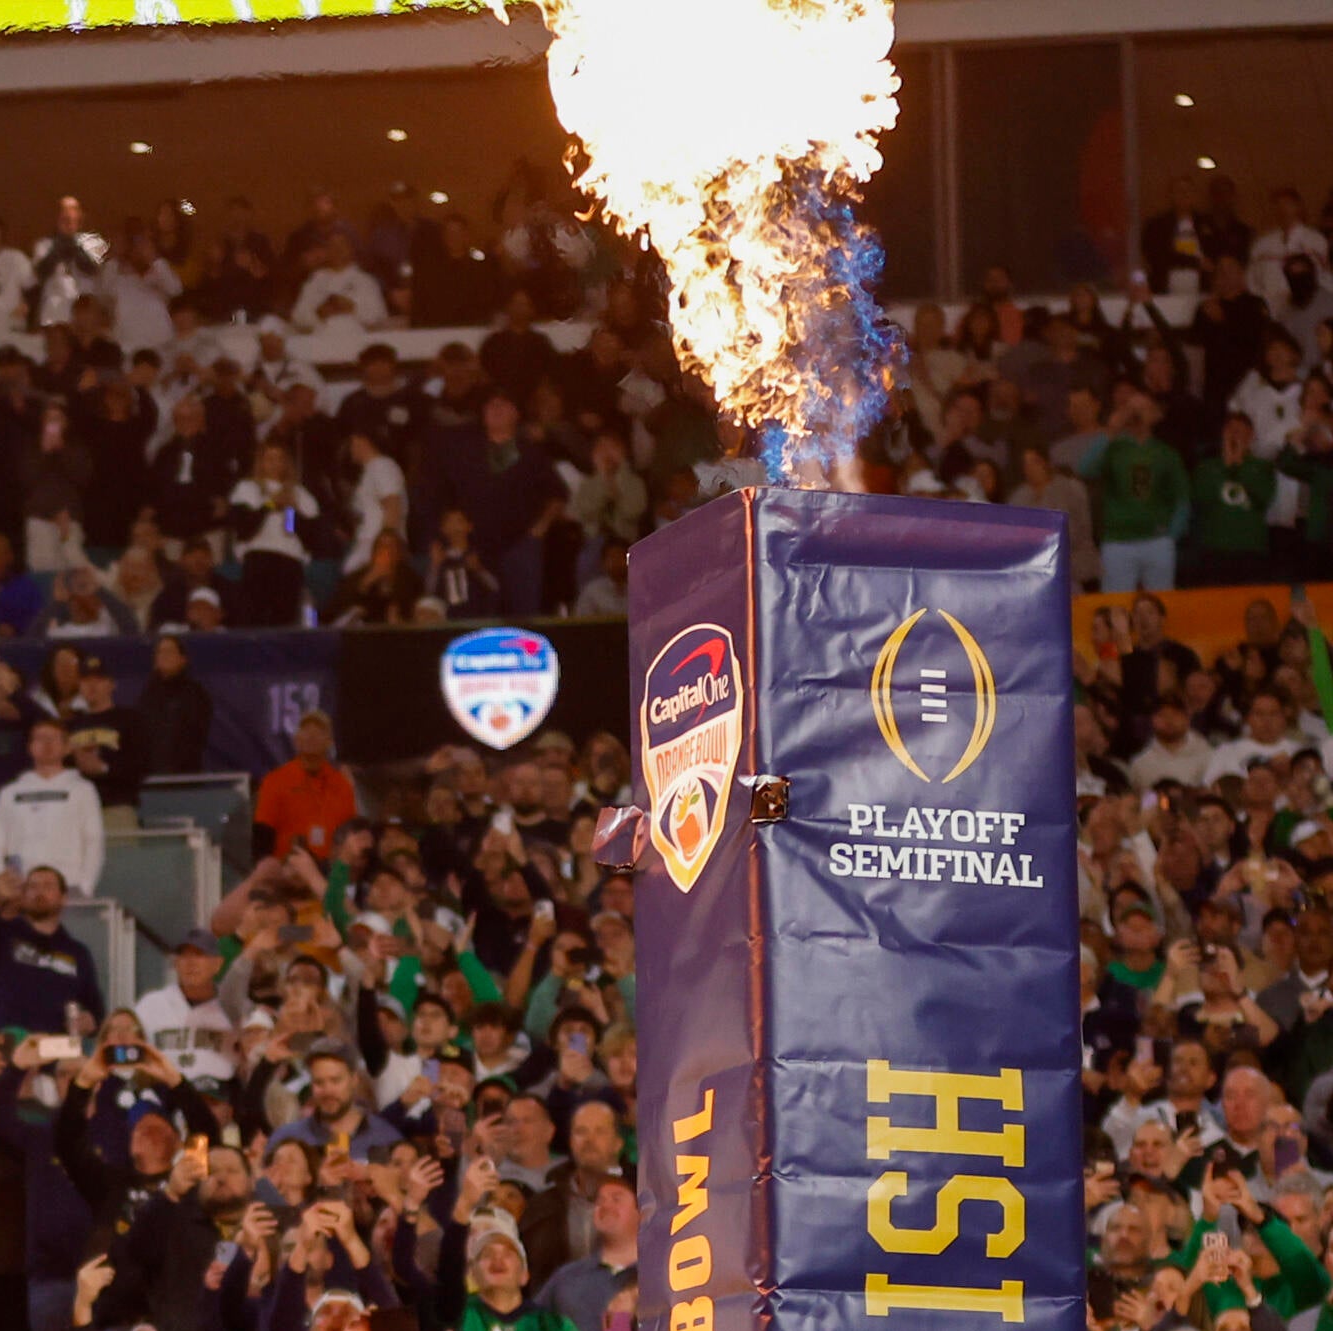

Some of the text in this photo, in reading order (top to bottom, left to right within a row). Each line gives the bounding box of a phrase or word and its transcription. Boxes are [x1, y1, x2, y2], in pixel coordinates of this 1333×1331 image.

[649, 671, 730, 725] CapitalOne
[847, 803, 1026, 846] PLAYOFF
[829, 843, 1043, 889] SEMIFINAL
